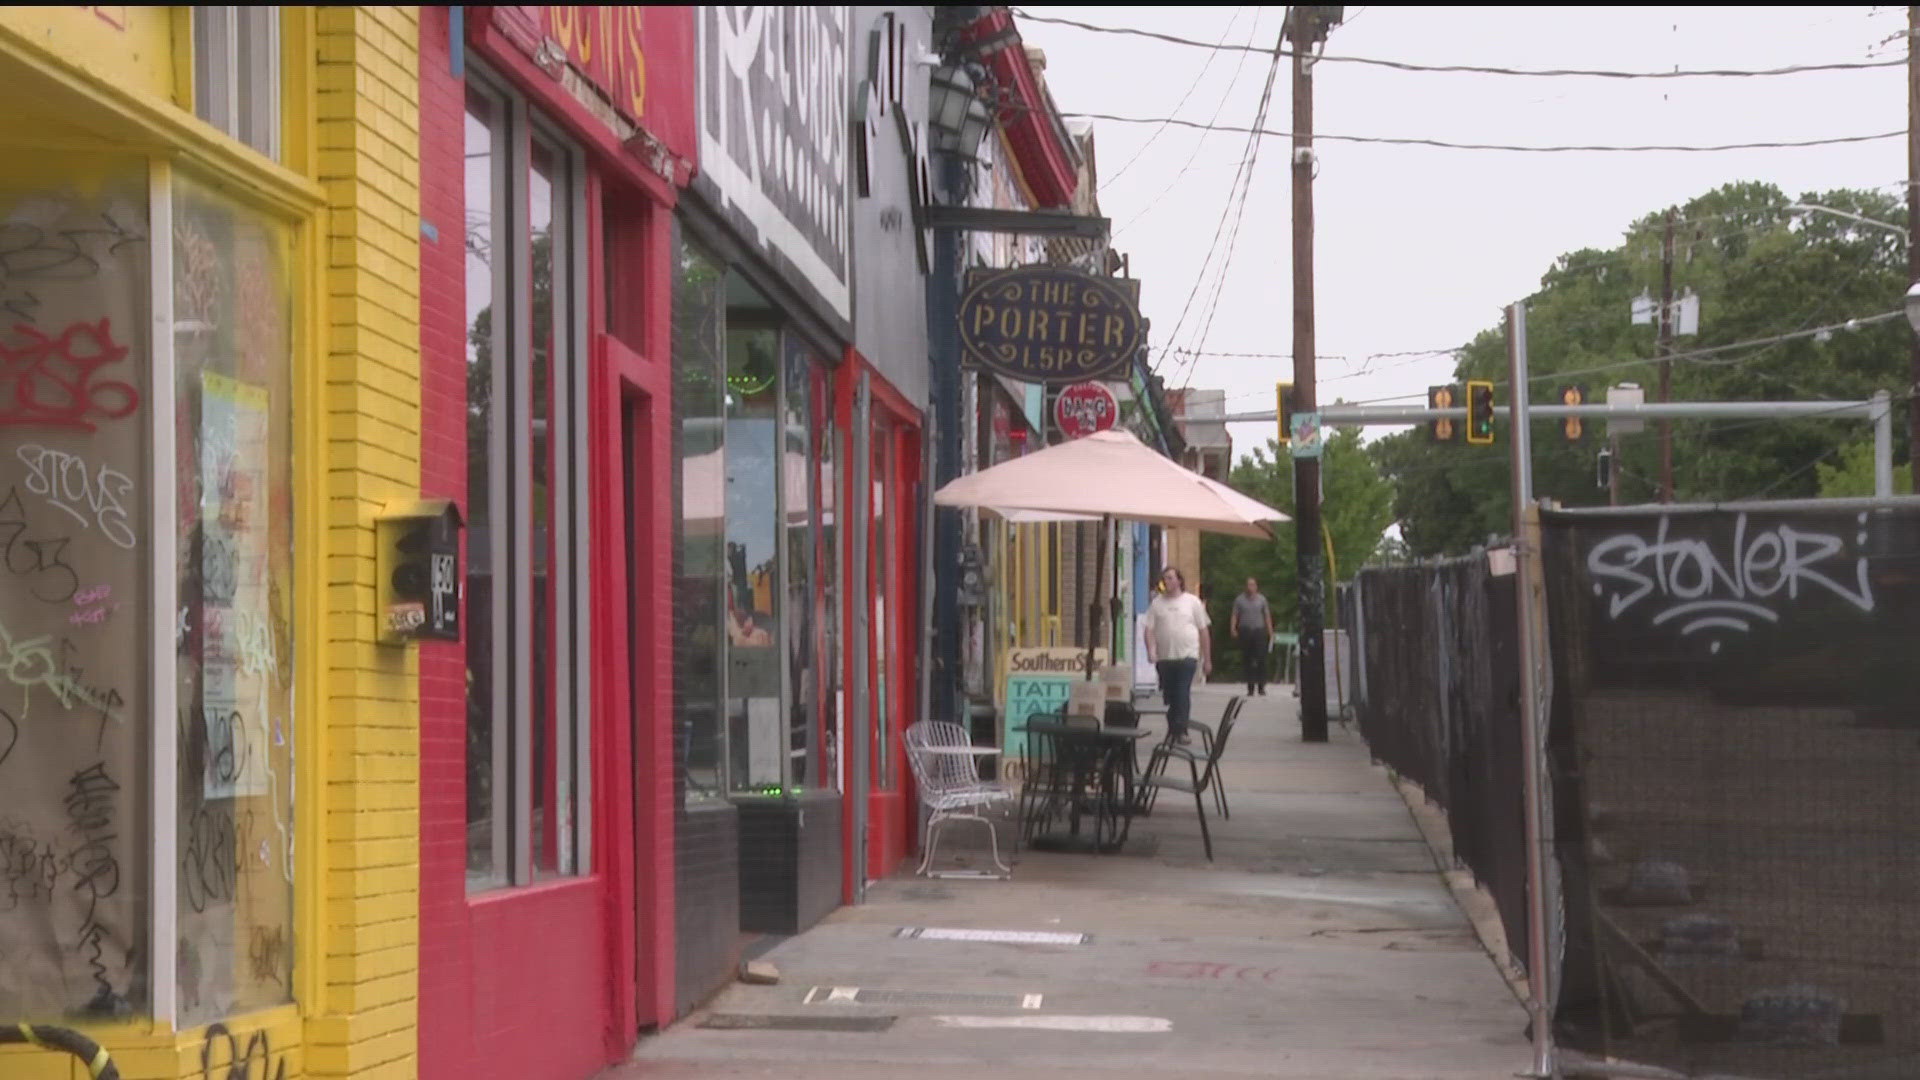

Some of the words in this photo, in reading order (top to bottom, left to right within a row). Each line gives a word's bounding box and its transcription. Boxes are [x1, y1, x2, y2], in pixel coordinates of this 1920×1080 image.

[1029, 280, 1076, 304] THE
[974, 304, 1125, 348] PORTER
[1012, 681, 1069, 697] TATT
